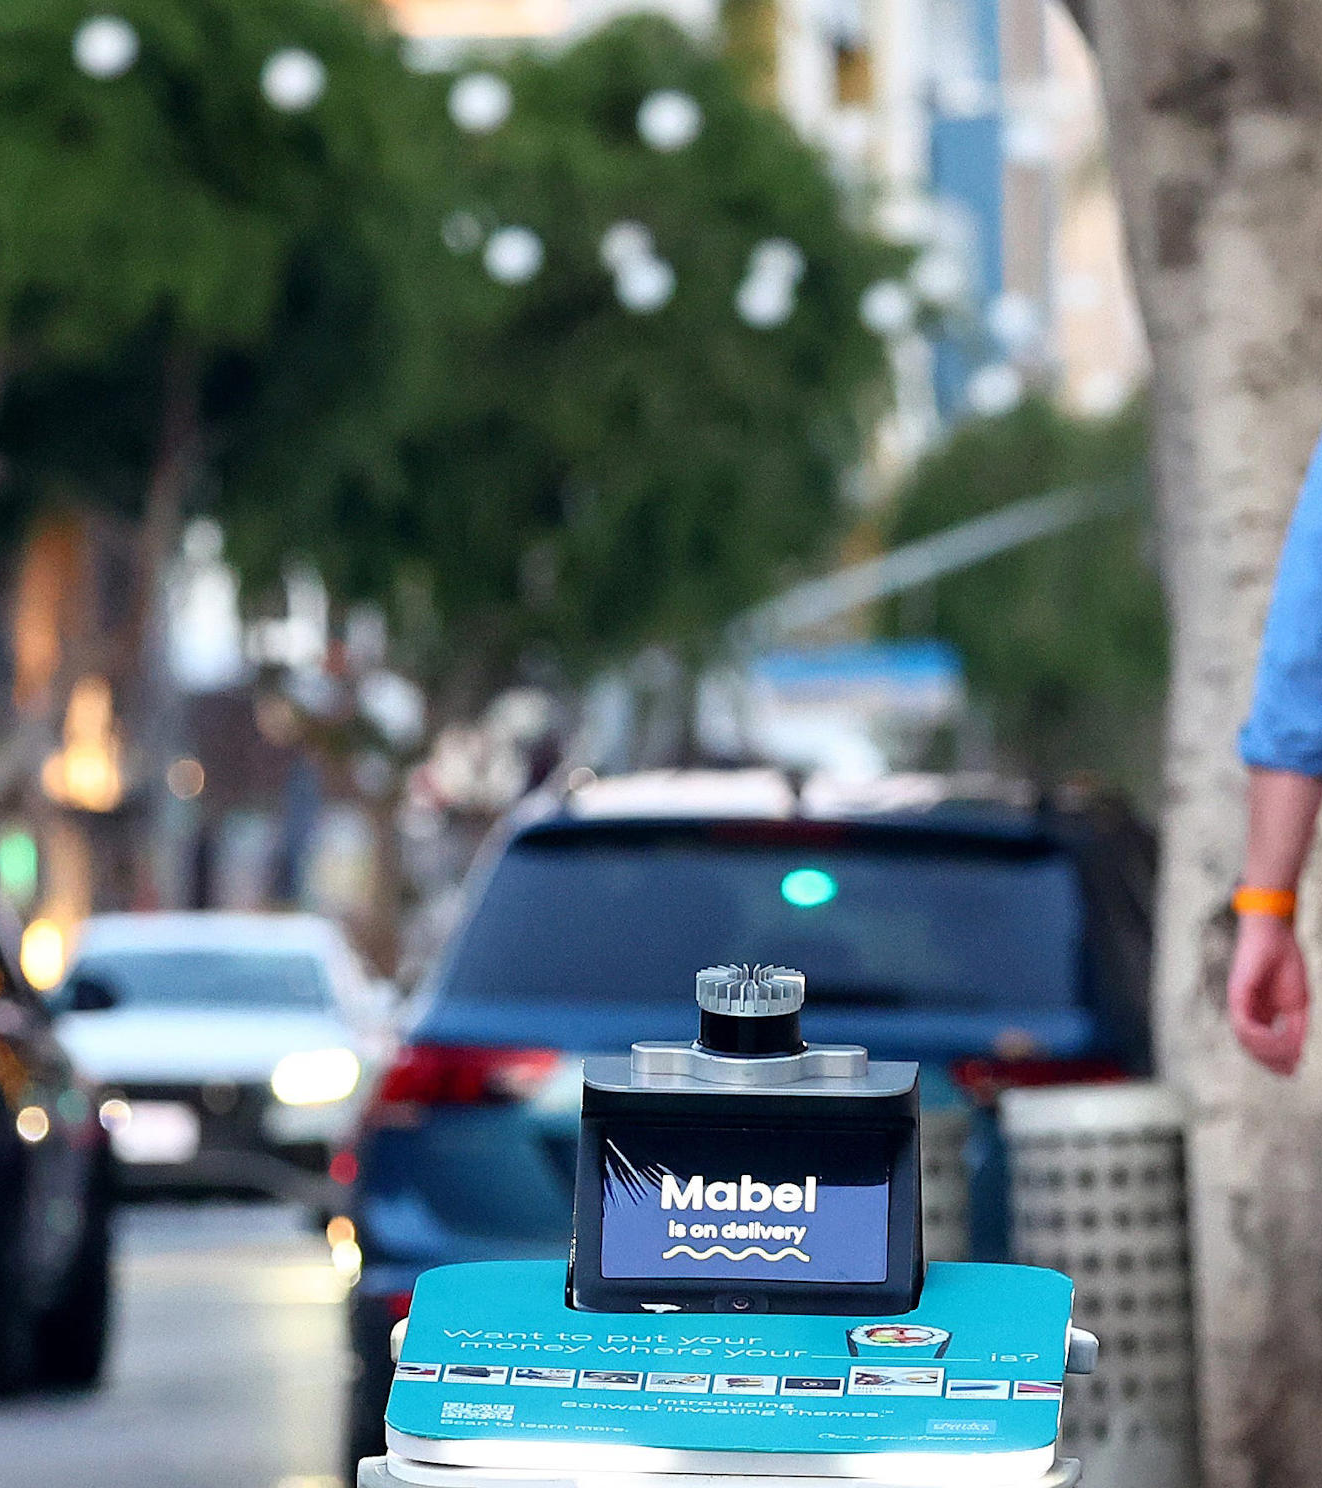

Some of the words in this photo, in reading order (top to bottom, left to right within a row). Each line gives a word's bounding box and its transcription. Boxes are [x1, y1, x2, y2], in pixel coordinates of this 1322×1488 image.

[660, 1174, 817, 1213] Mabel
[668, 1219, 686, 1238] is
[689, 1222, 718, 1239] on
[721, 1222, 807, 1245] delivery
[443, 1328, 543, 1340] Want
[556, 1332, 592, 1341] to
[607, 1334, 668, 1344] put
[678, 1336, 763, 1345] your
[460, 1341, 586, 1354] money
[598, 1345, 712, 1356] where
[723, 1349, 809, 1359] your
[990, 1352, 1040, 1363] is?
[561, 1401, 659, 1412] Schwab
[667, 1406, 776, 1417] Investing
[657, 1398, 795, 1410] Introducing
[521, 1422, 569, 1430] learn
